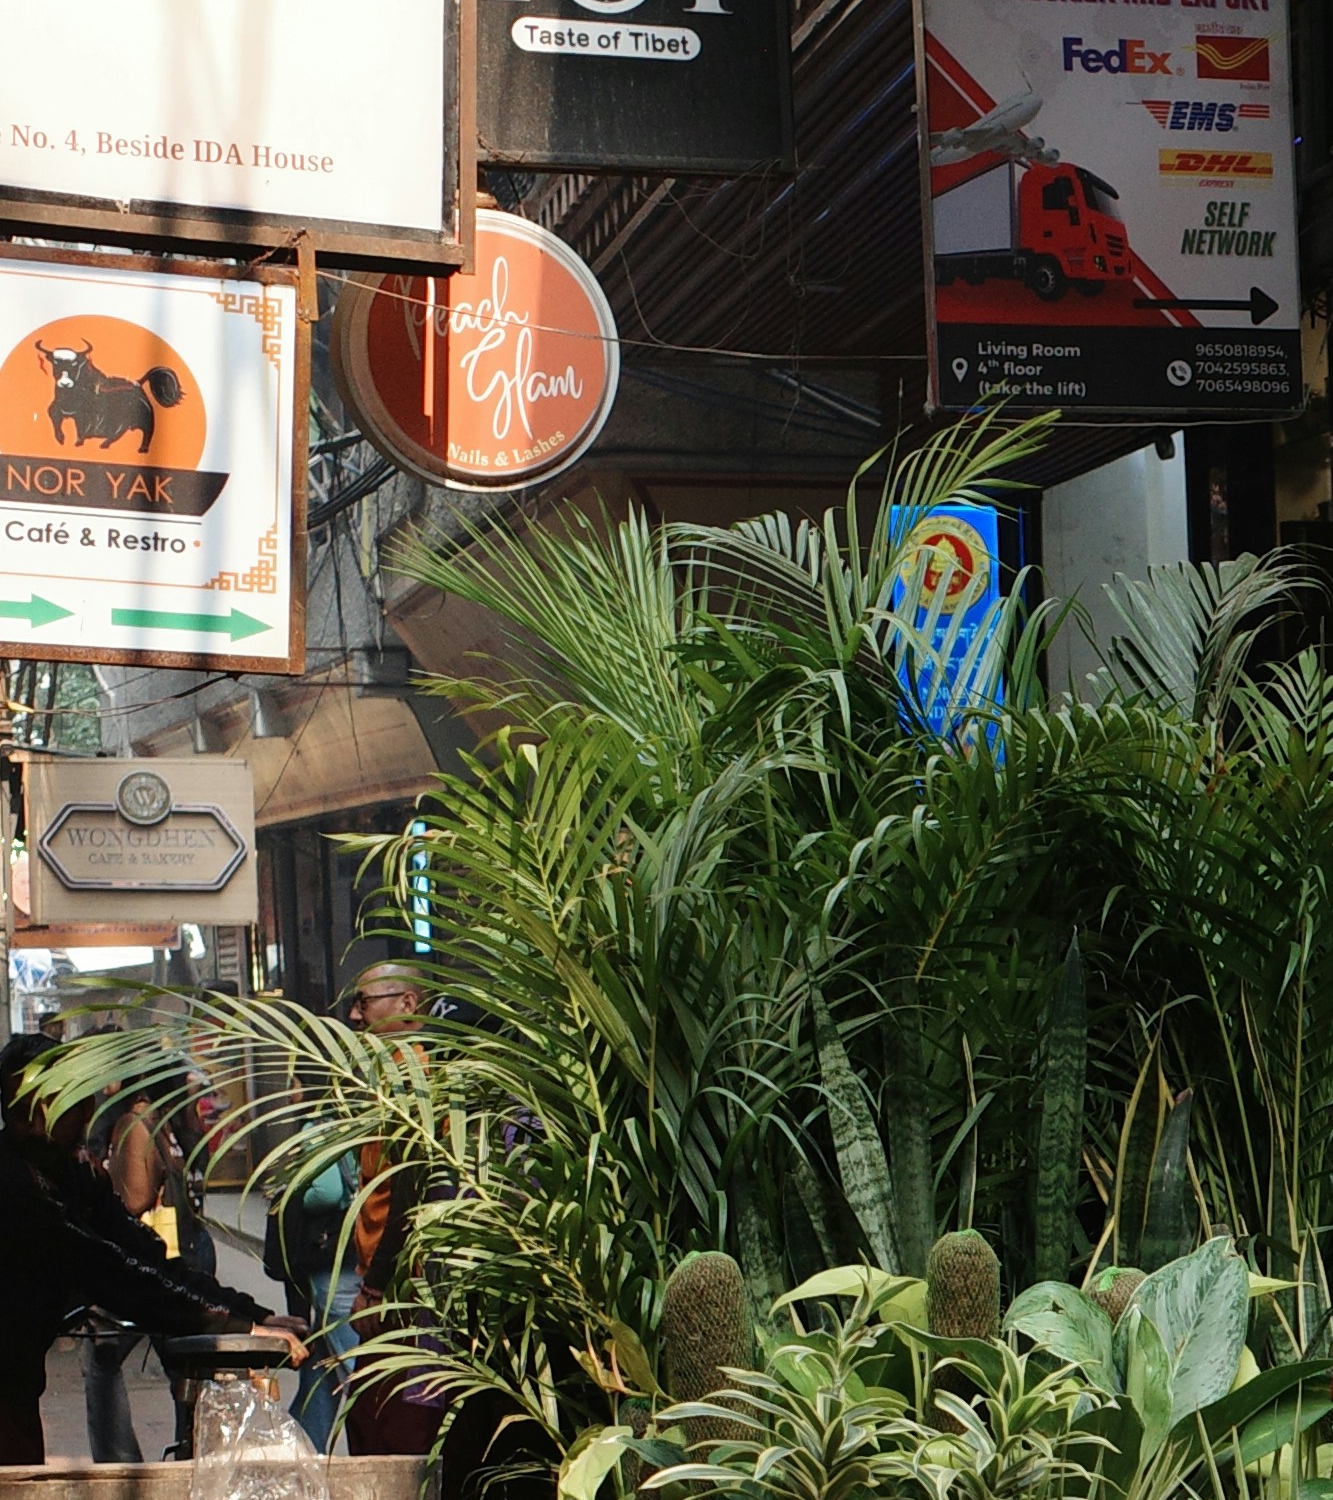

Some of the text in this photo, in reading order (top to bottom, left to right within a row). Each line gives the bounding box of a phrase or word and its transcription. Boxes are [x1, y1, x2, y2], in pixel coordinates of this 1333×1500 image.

[524, 24, 691, 57] Taste of Tibet
[1062, 37, 1173, 75] FedEx
[1169, 101, 1237, 132] EMS
[10, 124, 334, 173] No. 4, Beside IDA House
[1173, 152, 1257, 174] DHL
[1204, 200, 1250, 228] SELF
[1180, 229, 1277, 257] NETWORK
[977, 342, 1081, 359] Living Room
[977, 359, 1044, 377] 4th floor
[460, 327, 584, 440] Glam
[978, 380, 1088, 399] (take the lift)
[1196, 378, 1291, 394] 7065498096
[448, 430, 566, 467] Nails & Lashes
[7, 463, 173, 504] NOR YAK
[5, 520, 186, 554] Café & Restro
[67, 827, 217, 848] WONGDHEN
